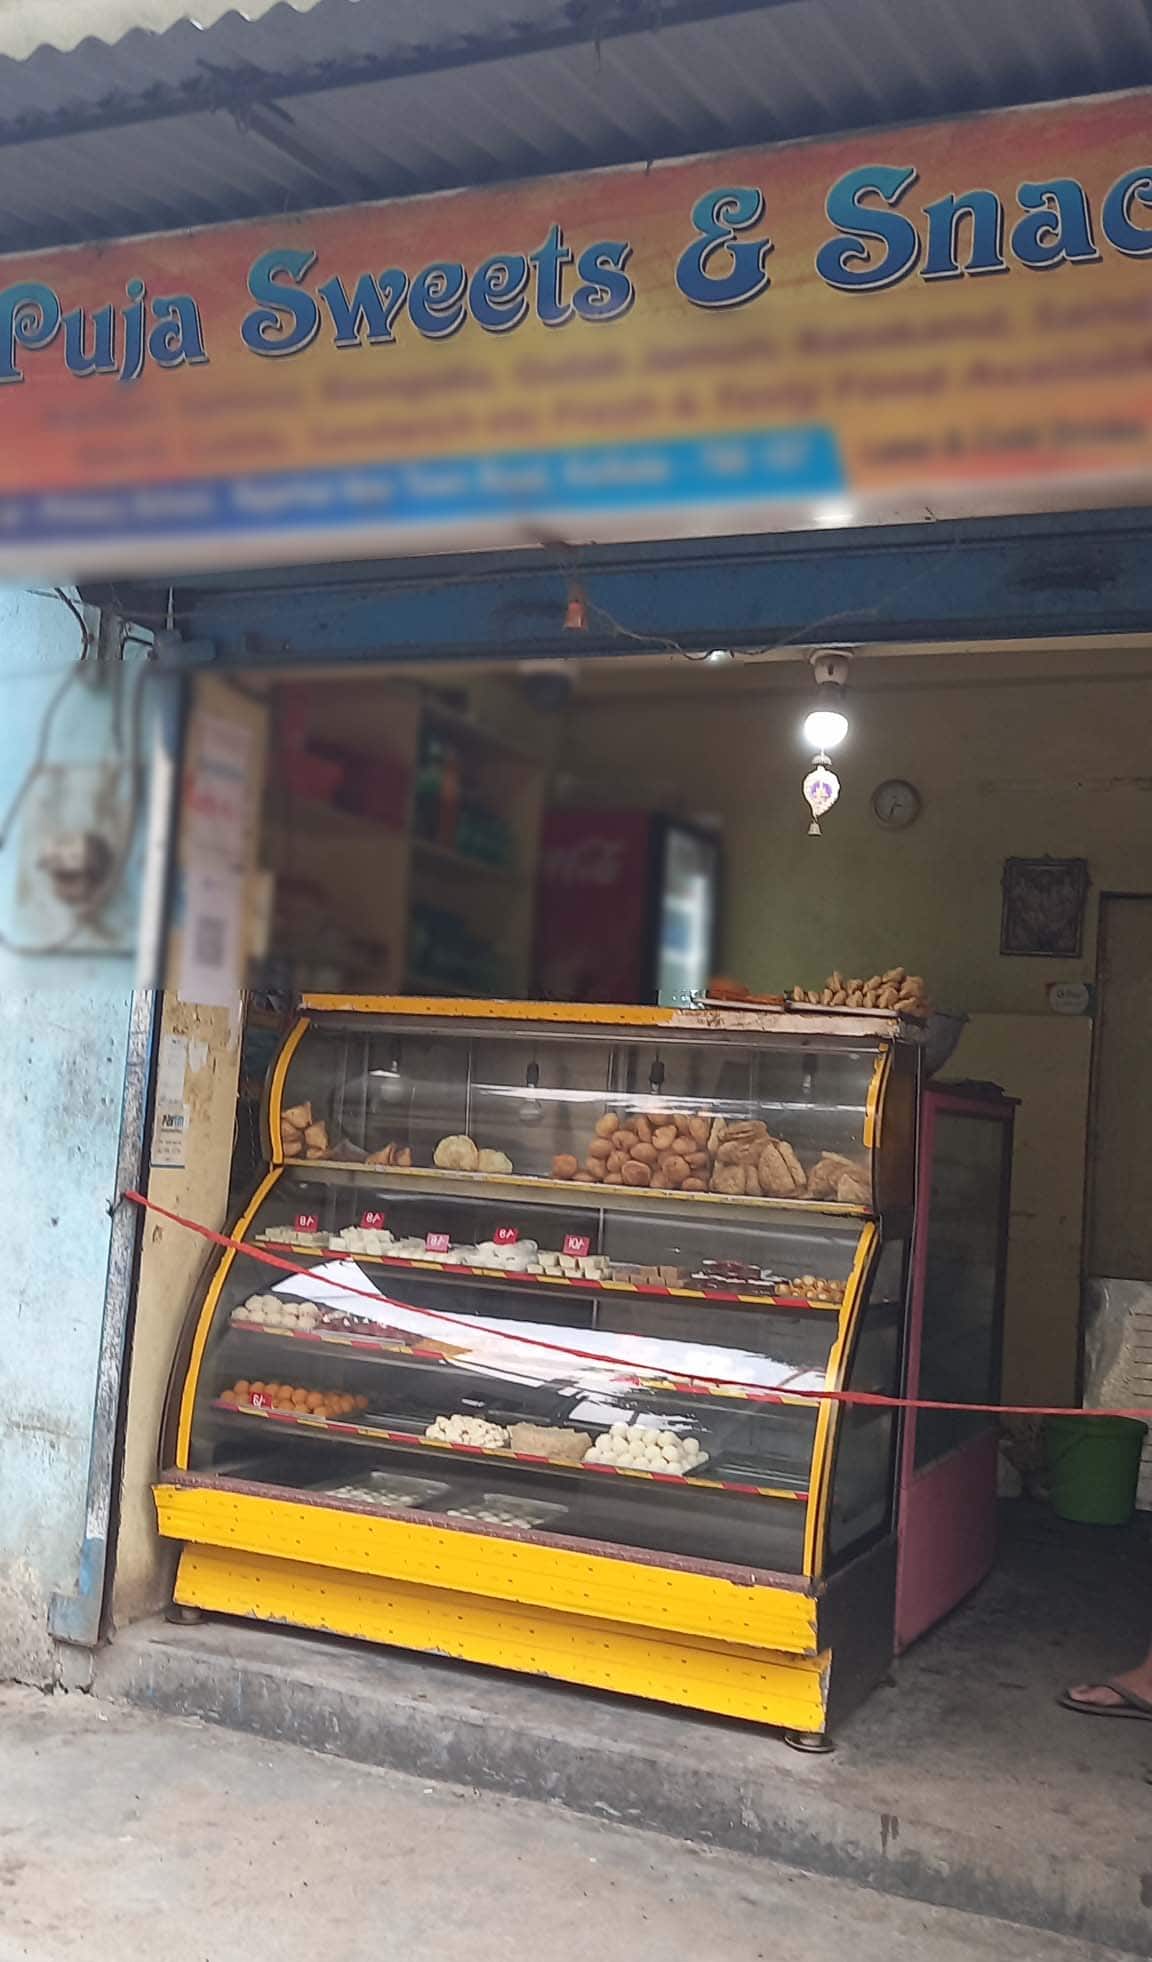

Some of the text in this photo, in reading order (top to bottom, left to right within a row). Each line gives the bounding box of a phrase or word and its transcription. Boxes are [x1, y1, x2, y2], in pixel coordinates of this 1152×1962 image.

[0, 280, 209, 382] Puja
[241, 222, 636, 357] Sweets
[675, 187, 774, 310] &
